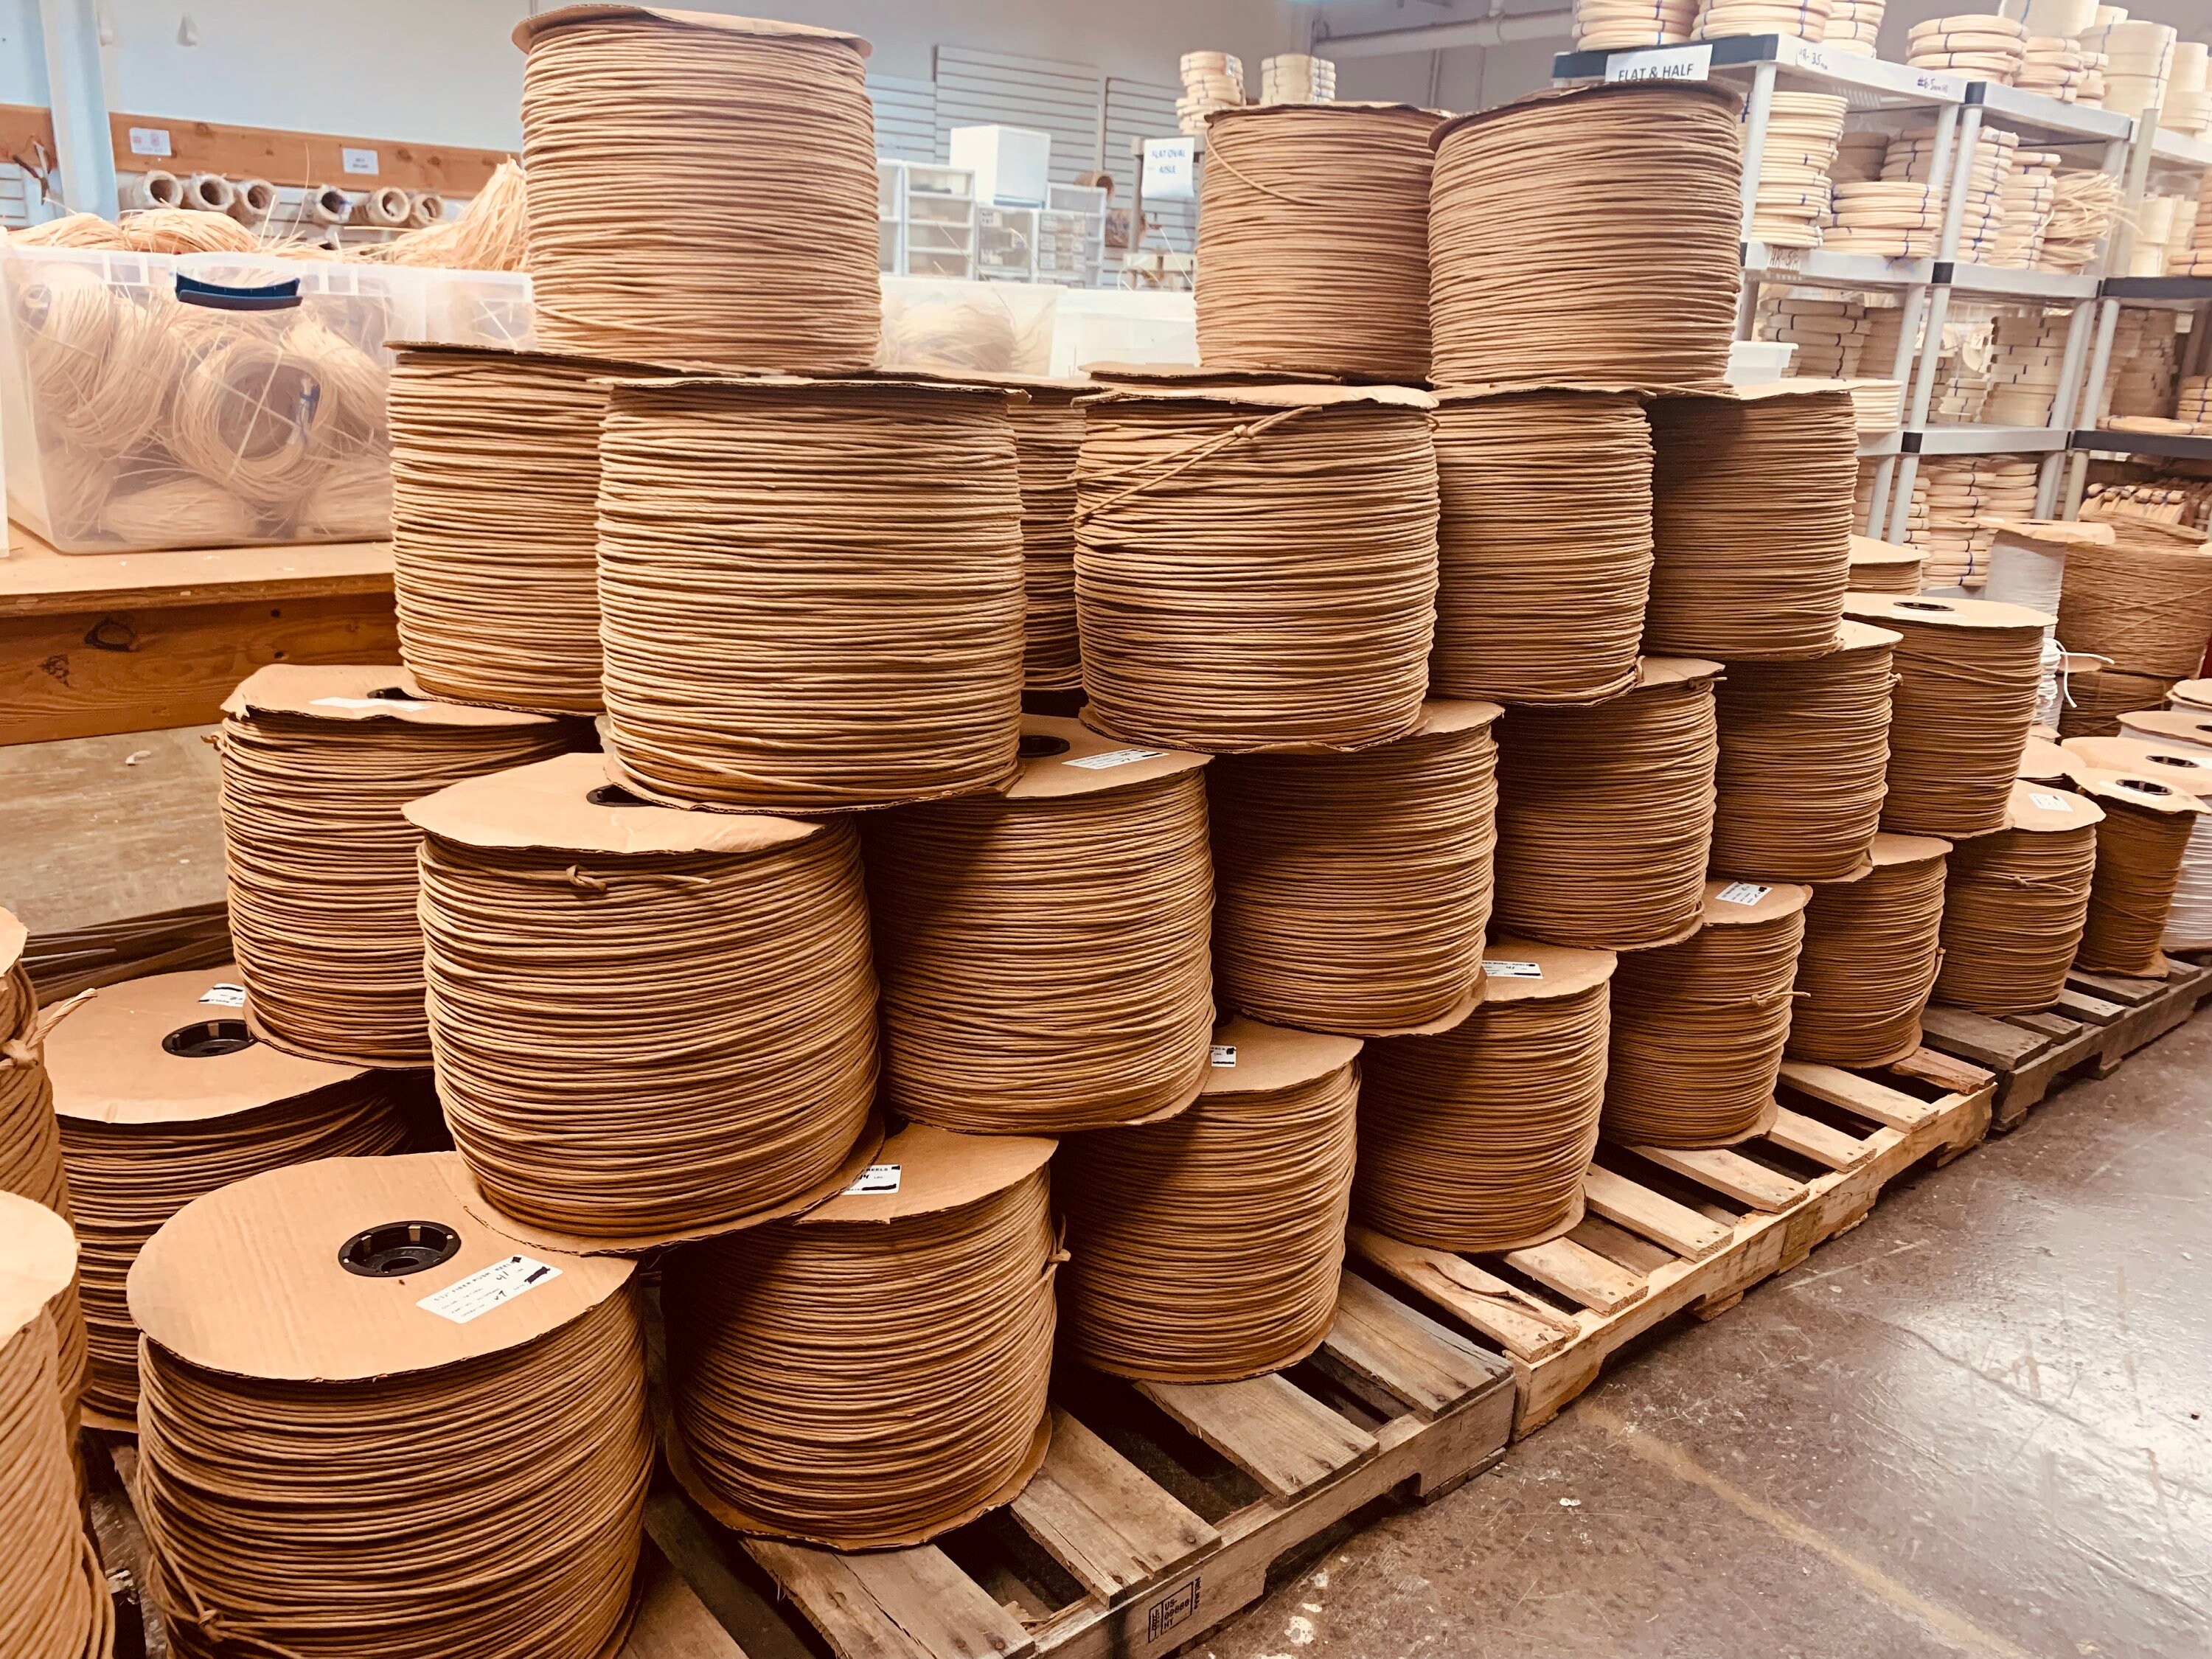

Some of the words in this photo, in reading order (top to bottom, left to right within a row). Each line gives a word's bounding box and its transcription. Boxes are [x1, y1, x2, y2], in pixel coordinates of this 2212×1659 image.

[1618, 68, 1646, 82] FLAT
[1649, 66, 1658, 79] &
[1663, 63, 1694, 77] HALF
[1164, 1599, 1178, 1611] US-
[1164, 1618, 1174, 1630] HT
